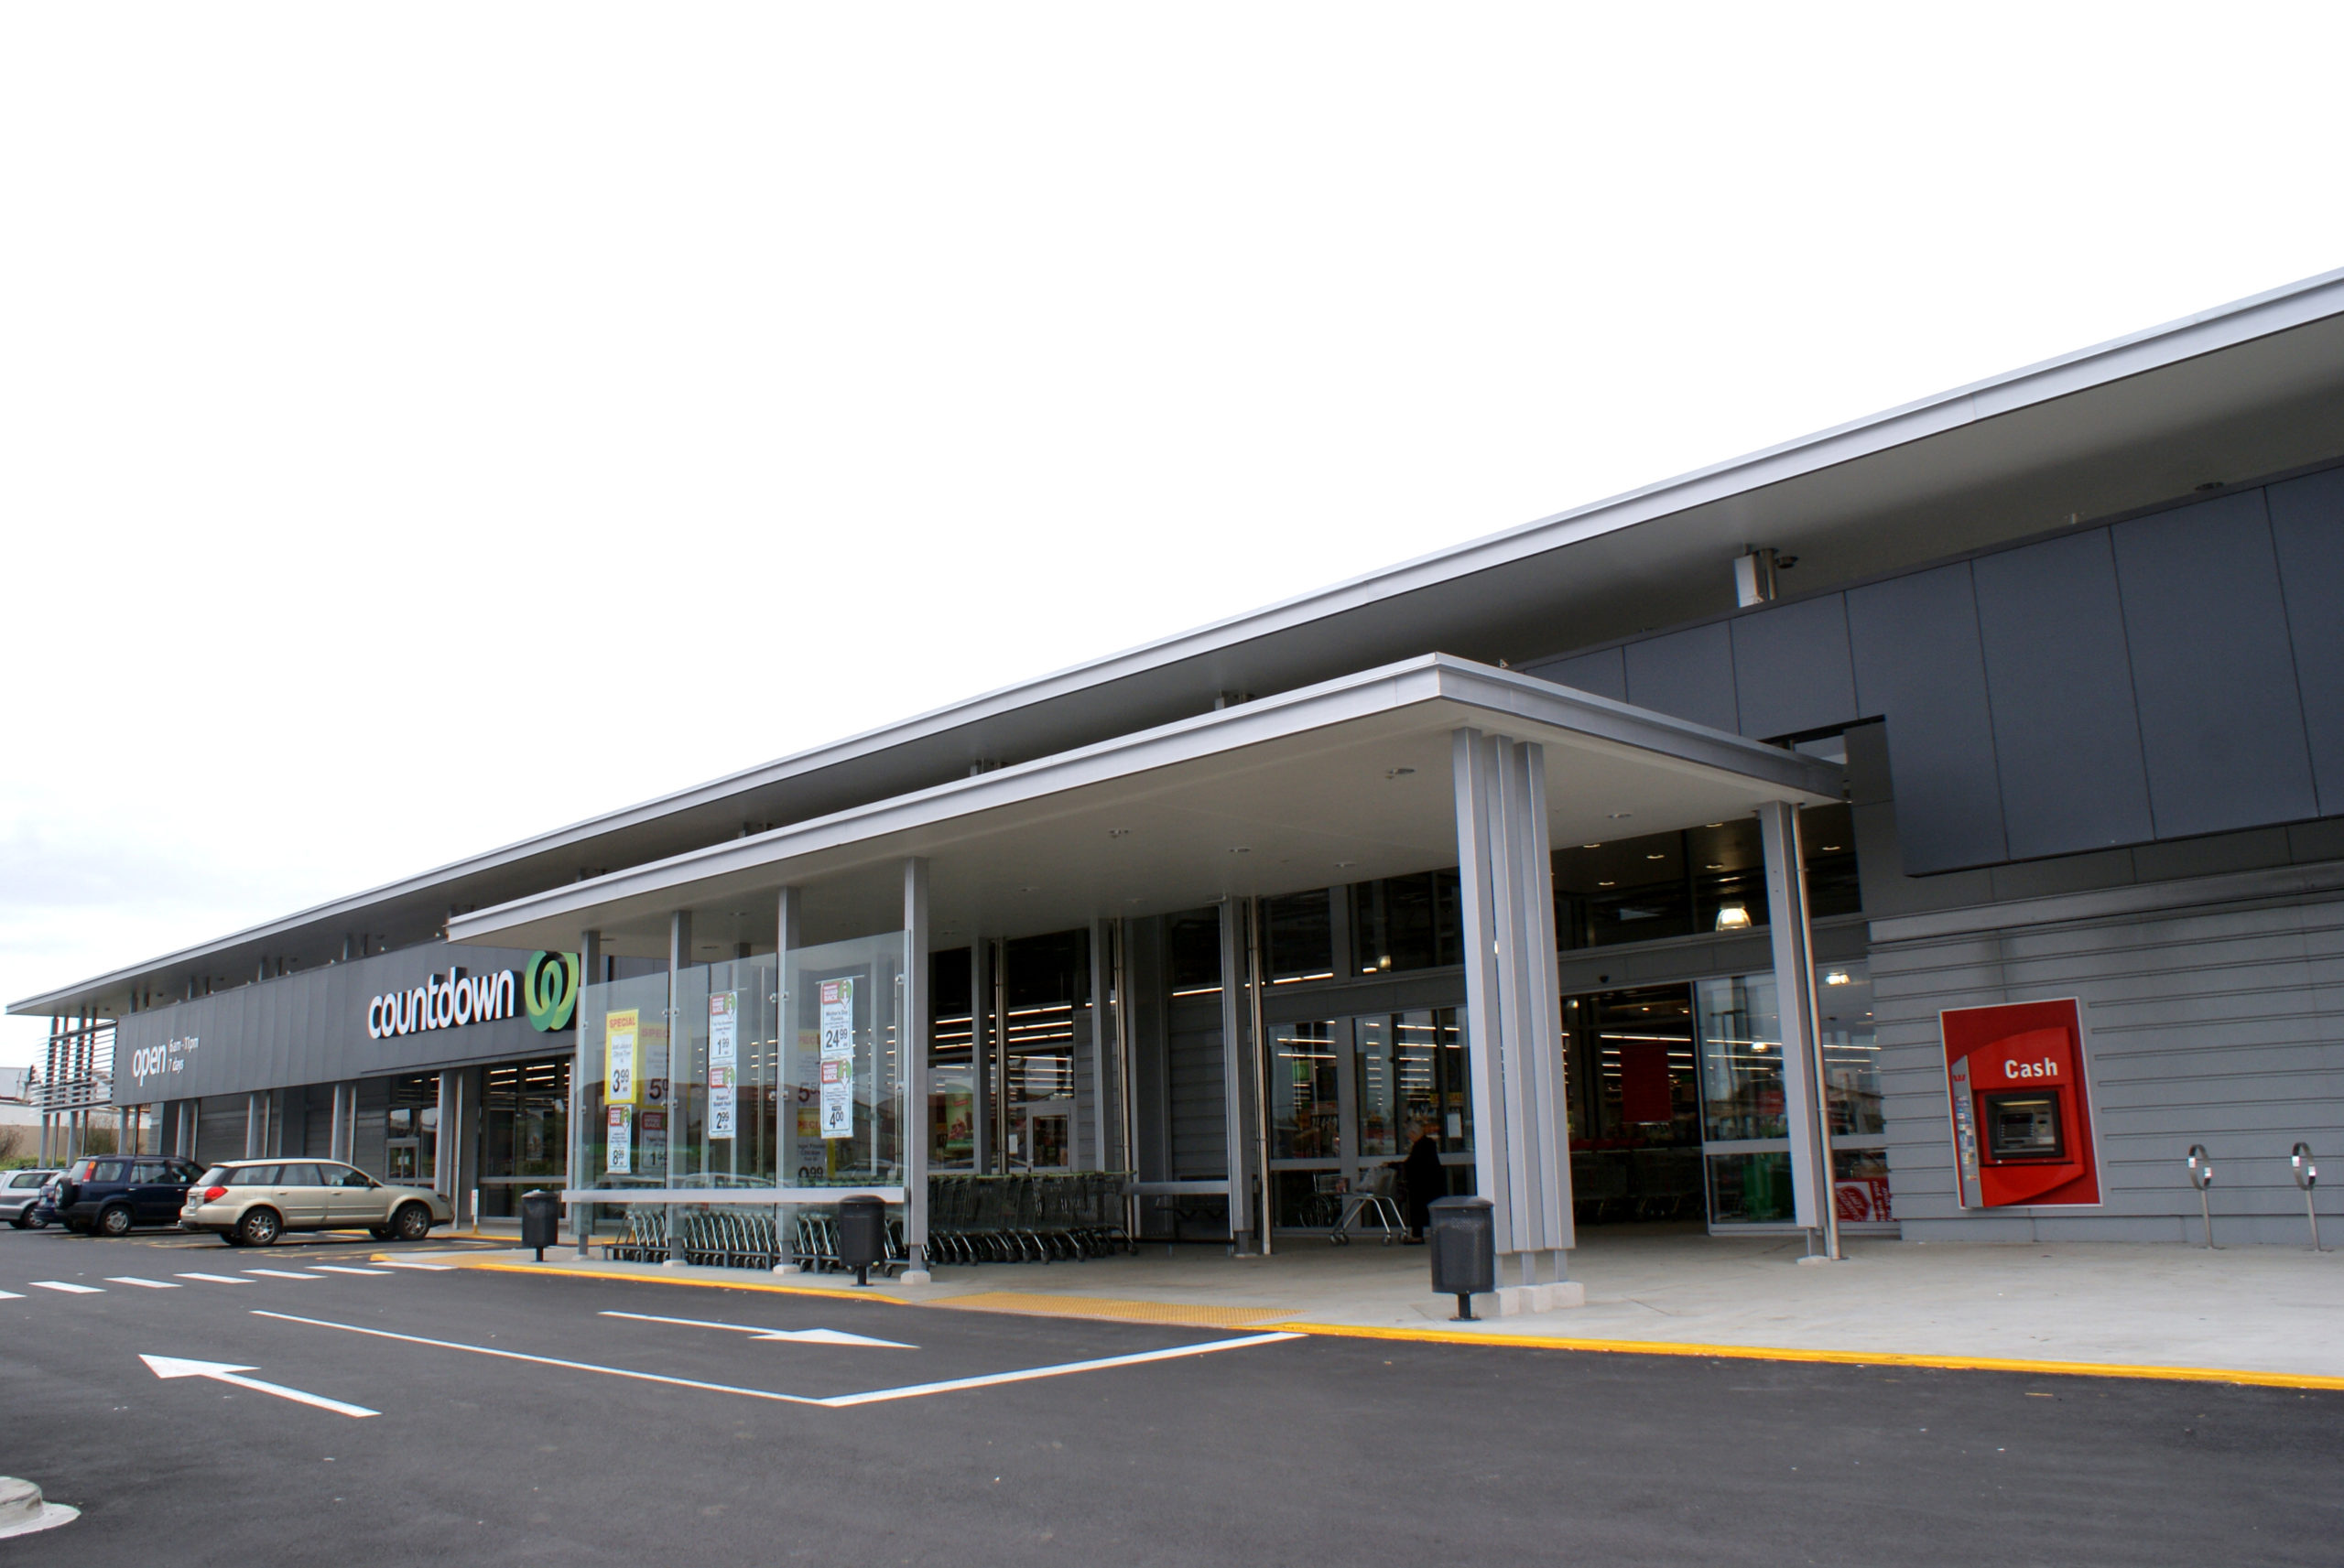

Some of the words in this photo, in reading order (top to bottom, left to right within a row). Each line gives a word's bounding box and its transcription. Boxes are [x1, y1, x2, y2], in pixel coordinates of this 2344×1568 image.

[368, 967, 515, 1039] countdown
[609, 1017, 635, 1028] SPECIAL
[641, 1027, 668, 1038] SPEC
[133, 1044, 167, 1087] open
[2004, 1057, 2058, 1078] Cash
[649, 1078, 668, 1099] 50
